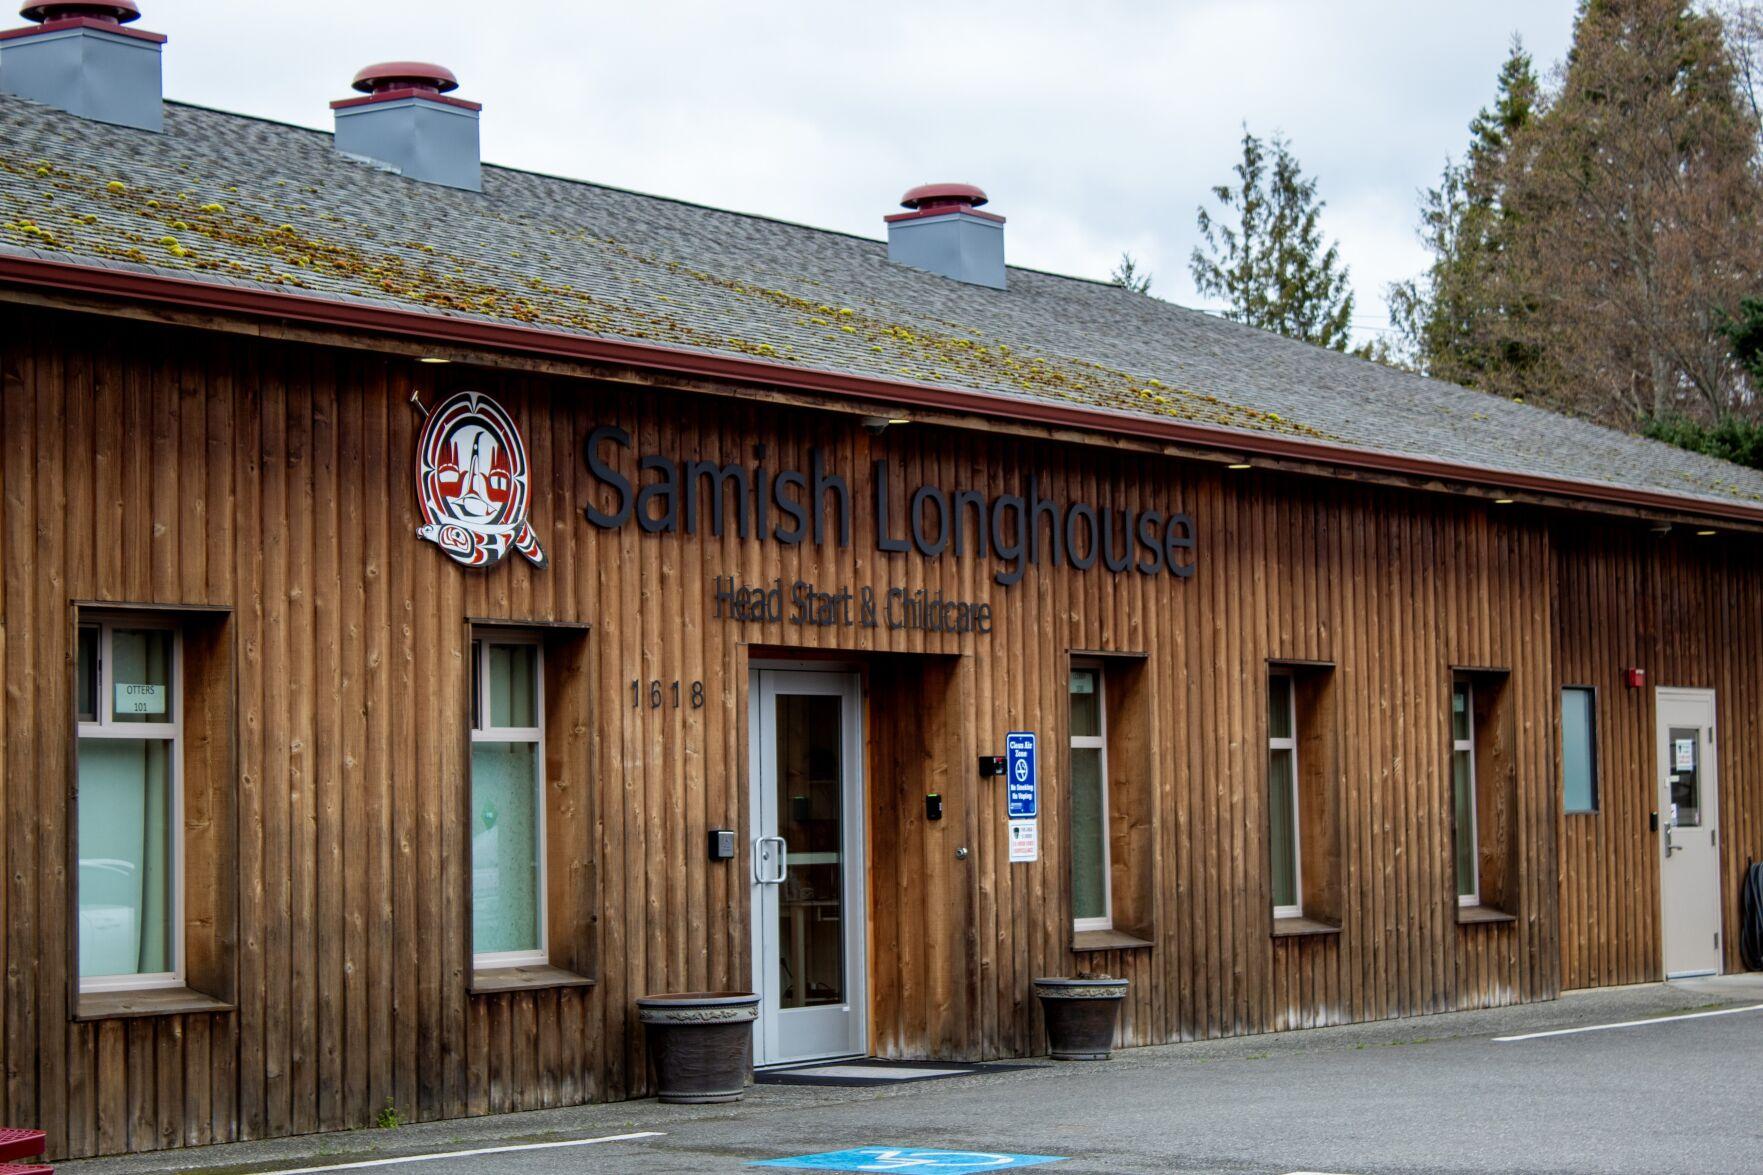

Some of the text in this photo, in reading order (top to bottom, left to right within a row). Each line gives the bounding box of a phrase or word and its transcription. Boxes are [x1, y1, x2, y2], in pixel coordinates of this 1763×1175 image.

[584, 425, 1196, 586] Samish Longhouse
[715, 574, 993, 635] Head Start & Childcare
[126, 685, 155, 695] OTTERS
[631, 679, 705, 709] 1618
[134, 702, 148, 712] 101
[1024, 741, 1033, 750] Air
